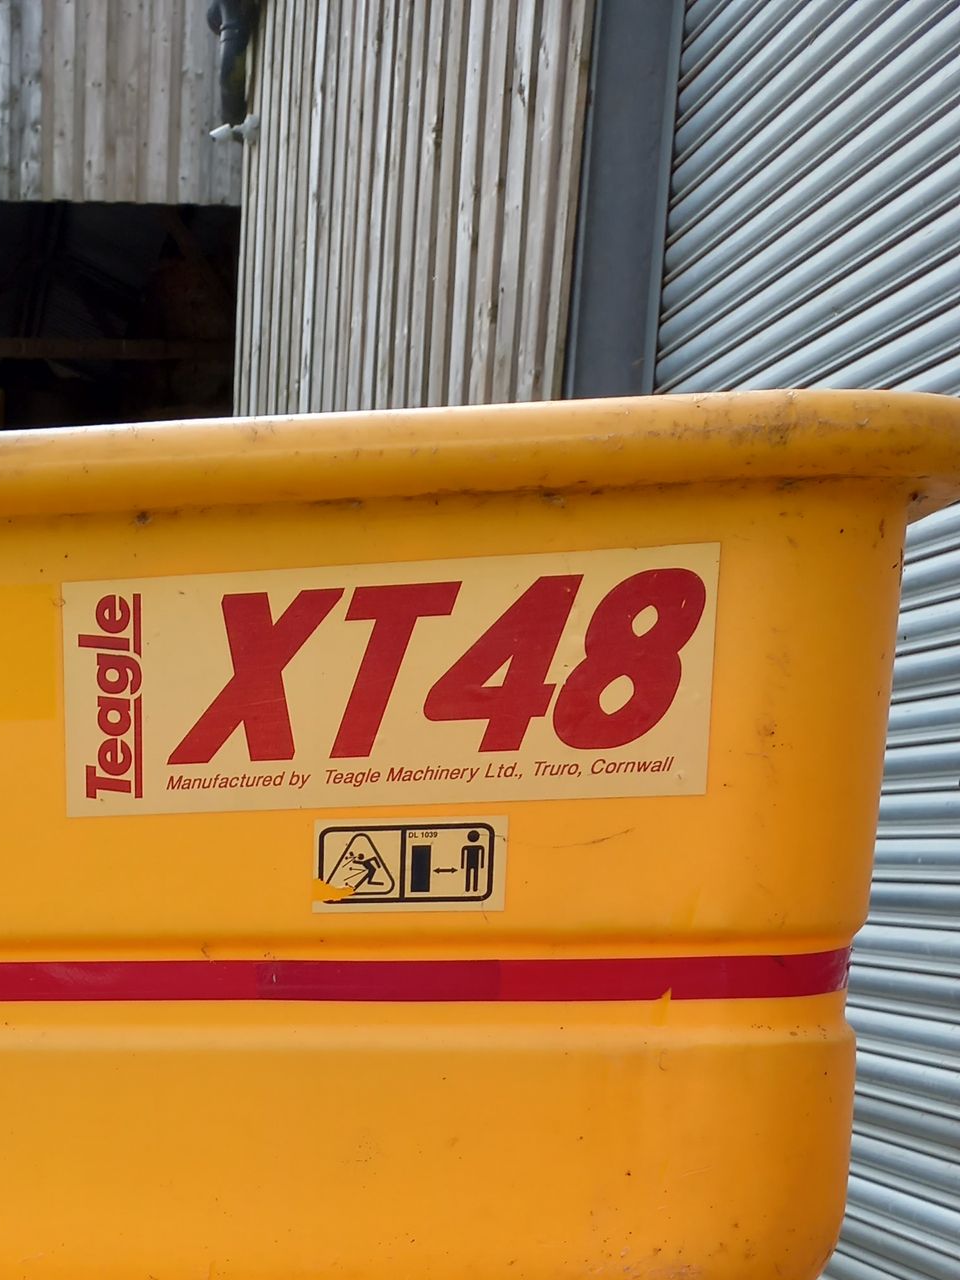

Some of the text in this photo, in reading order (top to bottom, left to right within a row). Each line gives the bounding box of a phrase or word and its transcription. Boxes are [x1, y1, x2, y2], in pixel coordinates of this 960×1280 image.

[78, 593, 142, 799] Teagle
[166, 567, 707, 766] XT48
[166, 757, 674, 791] Manufactured by Teagle Machinery Ltd., Truro, Cornwall
[421, 831, 438, 839] 1039
